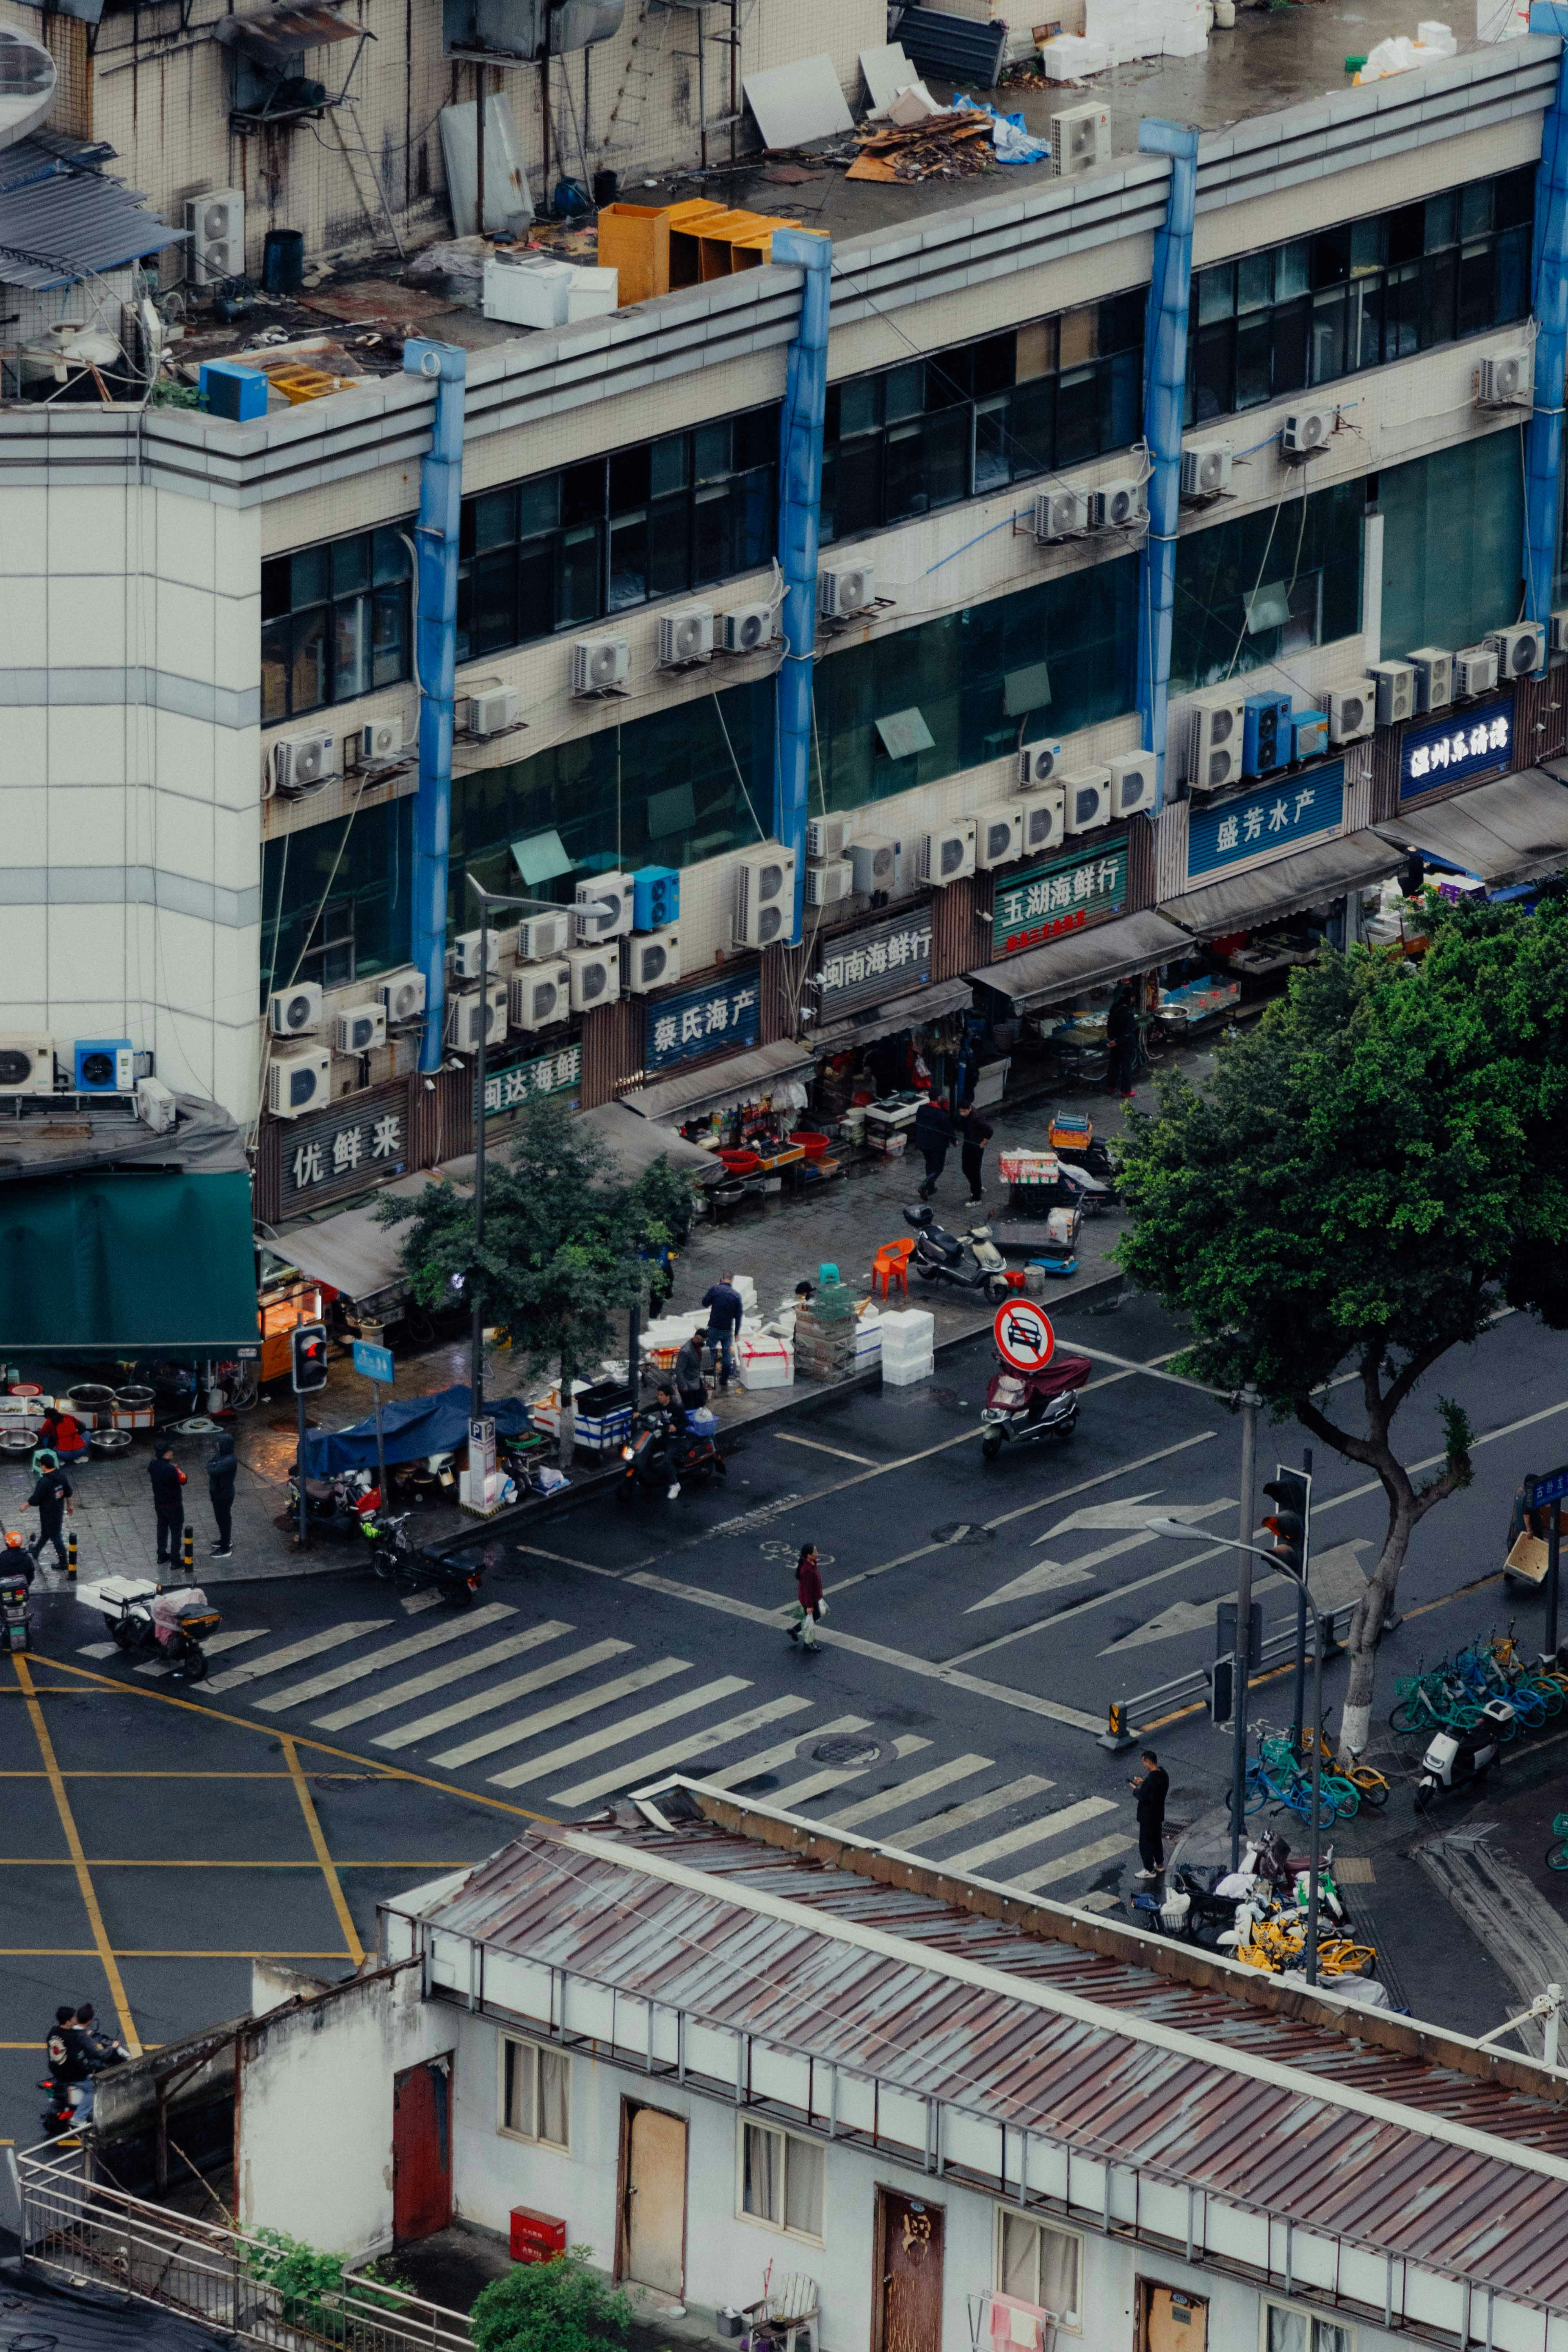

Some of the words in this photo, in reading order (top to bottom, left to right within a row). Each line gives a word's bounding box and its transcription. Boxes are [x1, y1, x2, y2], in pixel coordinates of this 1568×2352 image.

[1217, 789, 1316, 853] 盛芳水产
[1002, 858, 1119, 927] 五湖海鲜行
[822, 926, 933, 994] 闽南海鲜行
[654, 989, 755, 1052] 蔡氏海产
[293, 1114, 401, 1189] 优鲜来
